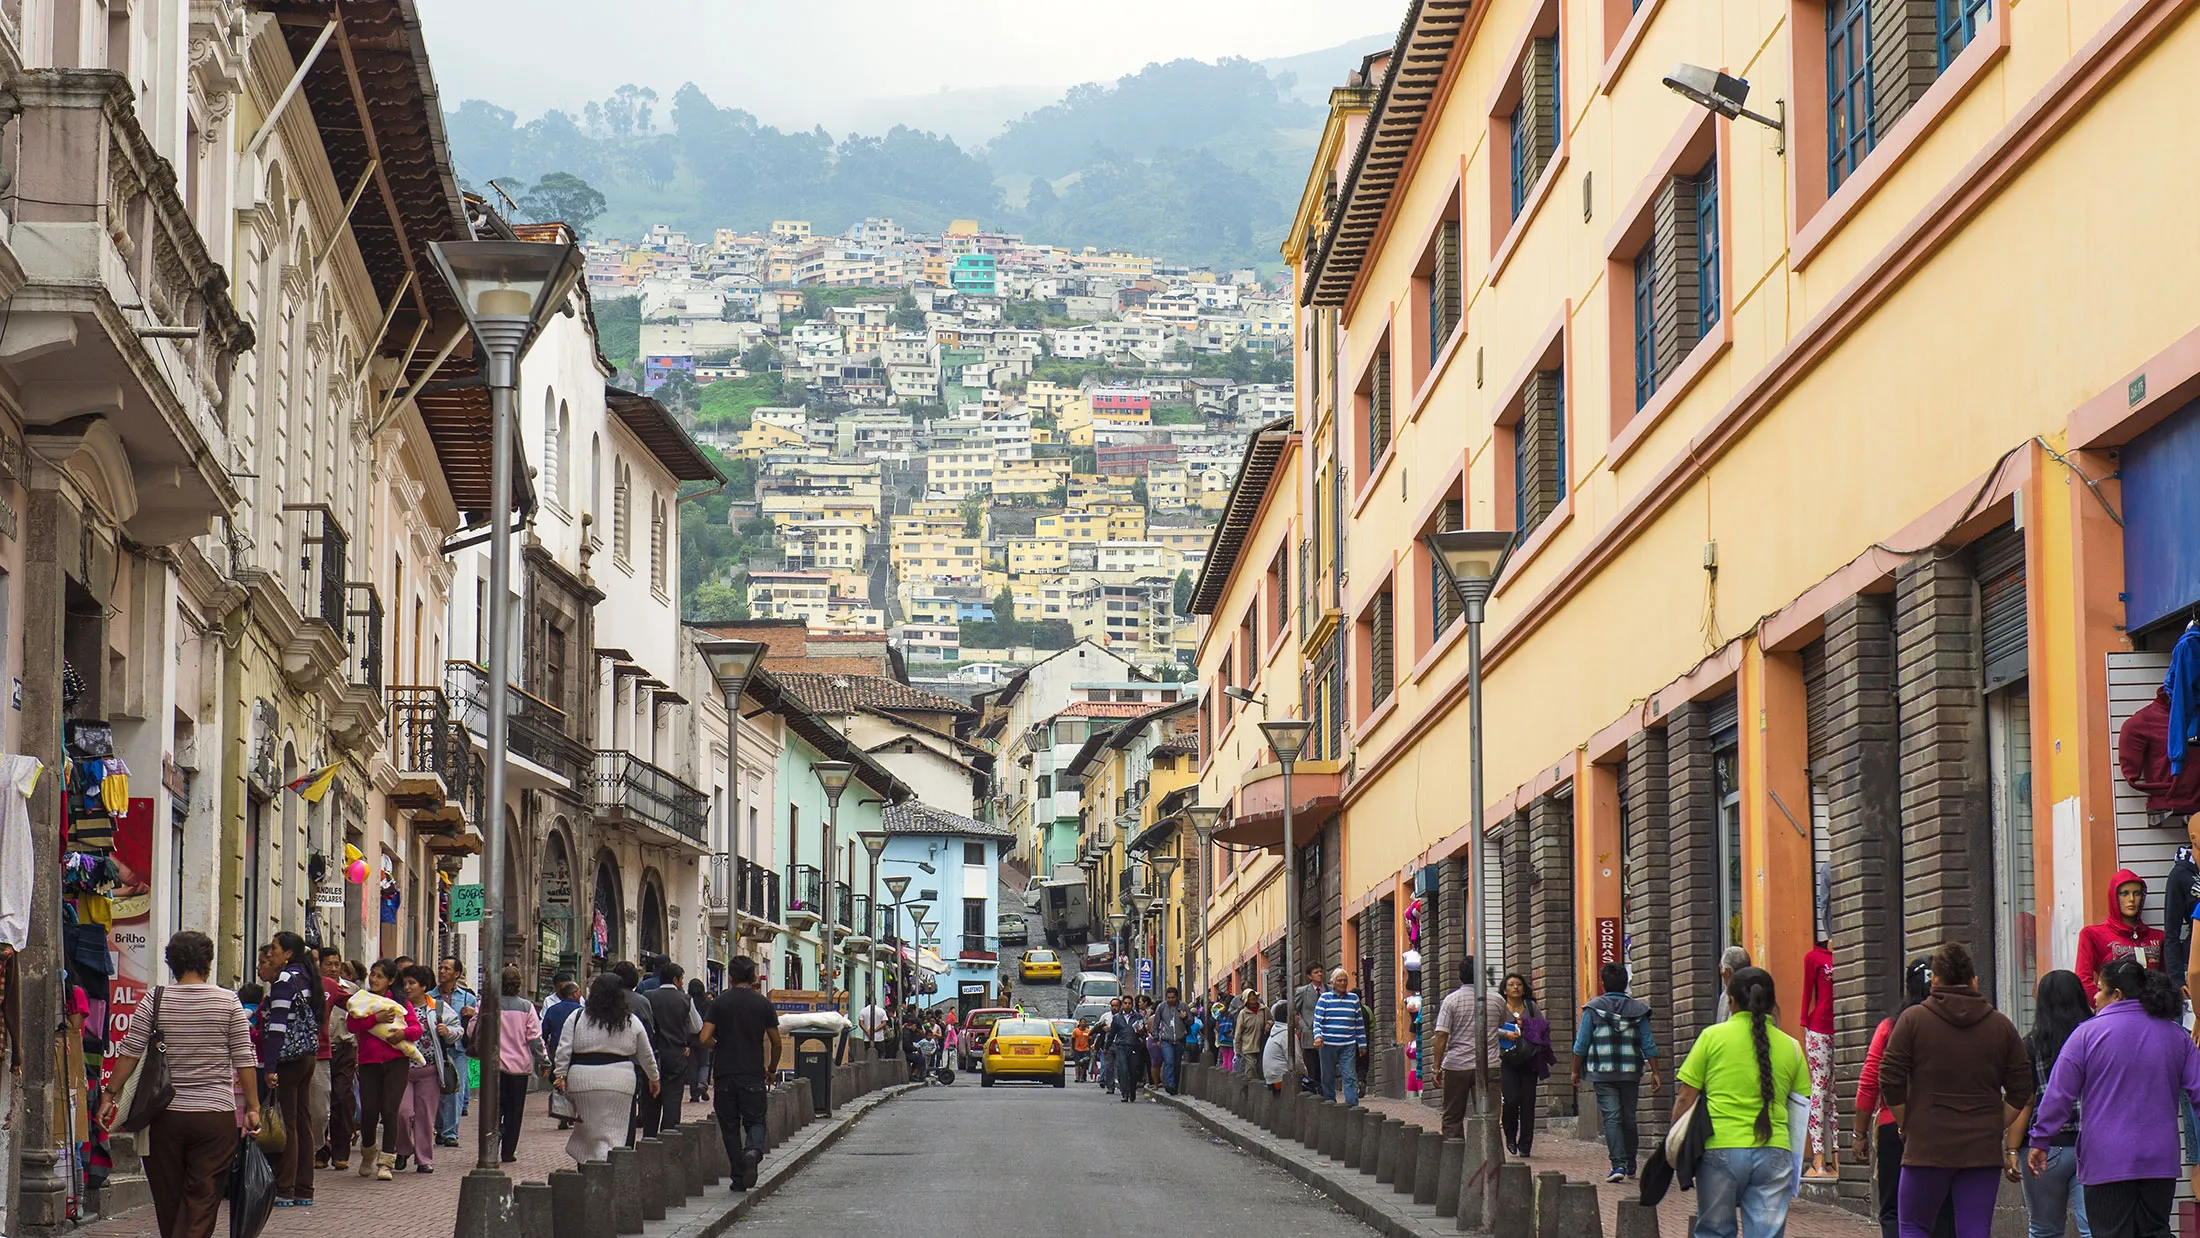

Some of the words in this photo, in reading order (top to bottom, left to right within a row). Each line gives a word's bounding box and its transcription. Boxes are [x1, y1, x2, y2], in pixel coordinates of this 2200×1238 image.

[316, 886, 343, 895] ANDILES
[315, 894, 343, 903] SCOLARES
[115, 933, 146, 943] Brilho
[1601, 920, 1614, 964] GORRAS
[113, 986, 137, 1004] AL
